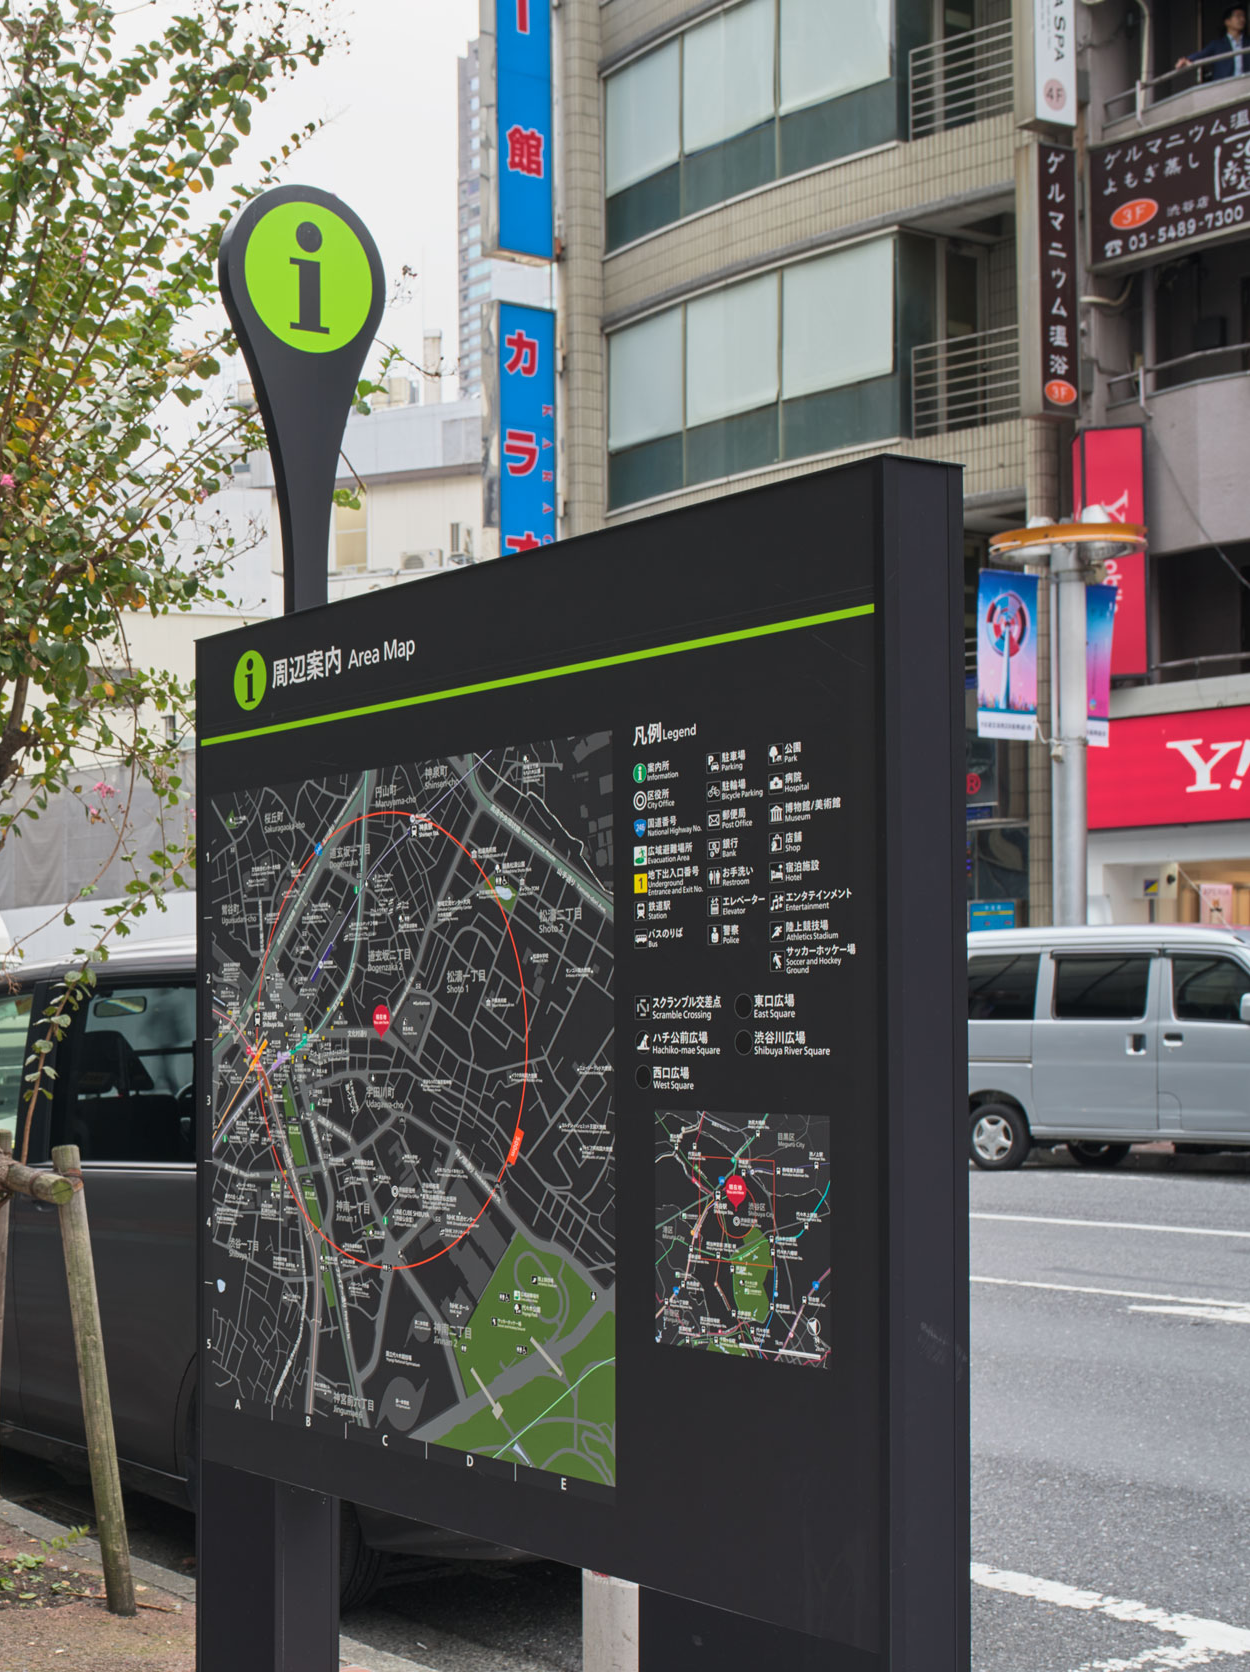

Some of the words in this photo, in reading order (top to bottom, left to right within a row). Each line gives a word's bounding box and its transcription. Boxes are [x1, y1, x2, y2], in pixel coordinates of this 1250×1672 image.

[1054, 15, 1065, 62] SPA
[1045, 86, 1063, 103] 4F
[1103, 153, 1200, 196] よもぎ蒸し
[1121, 203, 1147, 223] 3F
[1166, 196, 1209, 218] 渋谷店
[1128, 205, 1244, 251] 03-5489-7300
[1047, 151, 1069, 375] ゲルマニウム温浴
[1051, 384, 1069, 400] 3F
[271, 645, 342, 689] 周辺案内
[348, 647, 380, 670] Area
[384, 638, 416, 661] Map
[633, 722, 662, 747] 凡例
[662, 723, 697, 743] Legend
[784, 741, 802, 754] 公園
[721, 750, 746, 764] 駐車場
[784, 754, 798, 763] Park
[647, 760, 670, 773] 案内所
[721, 761, 743, 772] Parking
[1166, 739, 1250, 793] Y!
[647, 770, 679, 782] Information
[784, 772, 803, 784] 病院
[721, 779, 746, 792] 駐輪場
[784, 782, 810, 793] Hospital
[647, 789, 670, 801] 区役所
[722, 789, 742, 801] Bicycle
[742, 788, 764, 799] Parking
[647, 799, 658, 810] City
[658, 799, 675, 809] Office
[785, 797, 841, 813] 博物館/美術館
[722, 808, 746, 821] 郵便局
[785, 812, 811, 822] Museum
[647, 816, 677, 828] 国道番号
[722, 820, 735, 829] Post
[735, 819, 753, 828] Office
[647, 827, 667, 837] National
[667, 825, 692, 837] Highway
[692, 825, 702, 833] No.
[722, 837, 738, 849] 銀行
[785, 831, 803, 844] 店舗
[647, 842, 693, 856] 広域避難場所
[722, 849, 737, 858] Bank
[785, 843, 801, 853] Shop
[206, 852, 210, 862] 1
[648, 855, 676, 865] Evacuation
[677, 854, 690, 862] Area
[722, 866, 754, 878] お手洗い
[785, 860, 820, 873] 宿泊施設
[647, 866, 700, 880] 地下出入口番号
[785, 873, 802, 882] Hotel
[638, 877, 643, 890] 1
[648, 878, 684, 888] Underground
[722, 877, 750, 887] Restroom
[648, 887, 671, 896] Entrance
[671, 886, 681, 894] and
[693, 885, 704, 893] No.
[786, 887, 852, 900] エンタテインメント
[648, 900, 671, 912] 鉄道駅
[722, 896, 765, 907] エレベーター
[785, 901, 830, 911] Entertainment
[648, 911, 668, 920] Station
[722, 906, 746, 915] Elevator
[539, 926, 559, 934] Shoto
[559, 923, 564, 933] 2
[723, 924, 739, 936] 警察
[785, 919, 829, 932] 陸上競技場
[648, 928, 684, 939] バスのりば
[723, 935, 740, 944] Police
[786, 931, 812, 941] Athletics
[813, 931, 839, 940] Stadium
[648, 940, 658, 948] Bus
[786, 943, 856, 957] サッカーホッケー場
[786, 957, 805, 966] Soccer
[806, 957, 819, 965] and
[820, 956, 842, 967] Hockey
[786, 966, 810, 975] Ground
[206, 973, 211, 984] 2
[446, 986, 464, 994] Shoto
[465, 985, 469, 993] 1
[652, 995, 722, 1010] スクランブル交差点
[754, 993, 795, 1008] 東口広場
[652, 1009, 681, 1020] Scramble
[682, 1010, 712, 1022] Crossing
[754, 1008, 769, 1018] East
[770, 1008, 796, 1020] Square
[652, 1030, 708, 1045] ハチ公前広場
[754, 1030, 806, 1045] 渋谷川広場
[652, 1045, 693, 1055] Hachiko-mae
[694, 1045, 721, 1056] Square
[754, 1045, 781, 1056] Shibuya
[782, 1045, 801, 1056] River
[802, 1046, 831, 1058] Square
[652, 1066, 690, 1080] 西口広場
[653, 1080, 671, 1089] West
[672, 1080, 694, 1091] Square
[206, 1095, 211, 1106] 3
[206, 1217, 212, 1227] 4
[206, 1338, 212, 1349] 5
[234, 1399, 241, 1410] A
[305, 1415, 311, 1427] B
[382, 1434, 388, 1447] C
[466, 1455, 474, 1467] D
[560, 1477, 567, 1490] E
